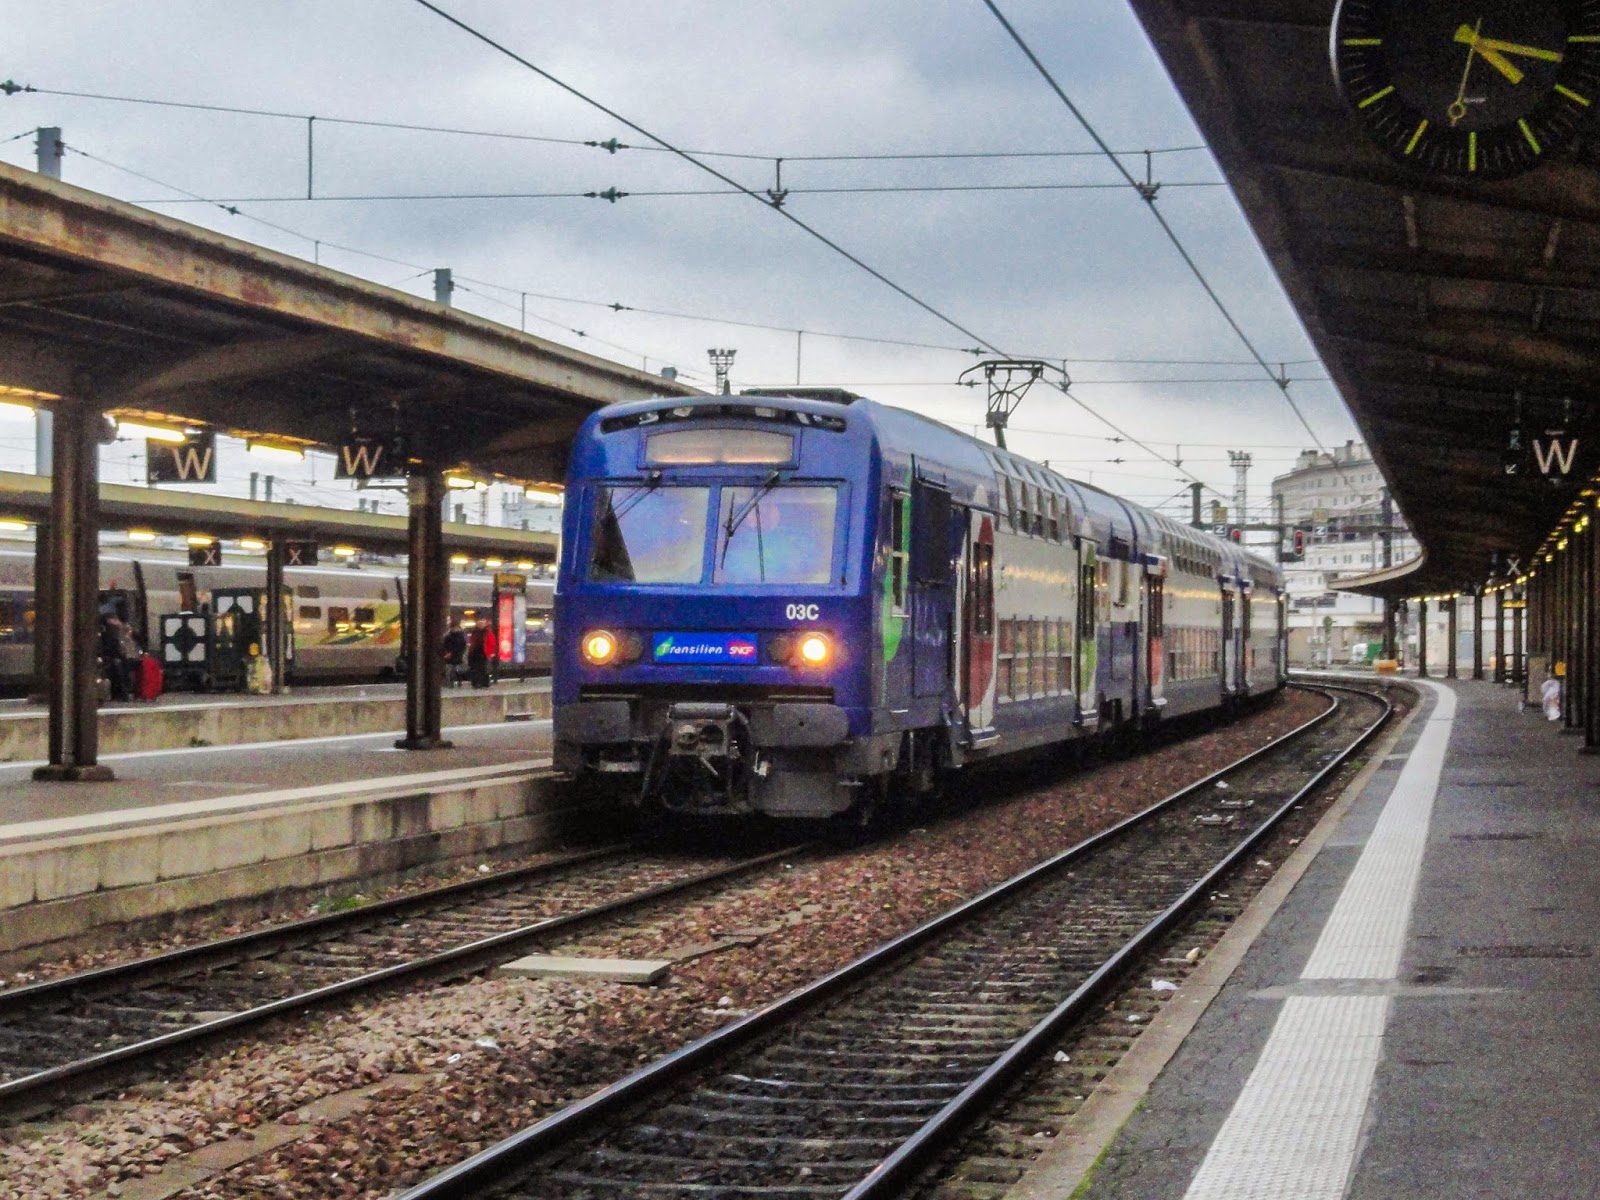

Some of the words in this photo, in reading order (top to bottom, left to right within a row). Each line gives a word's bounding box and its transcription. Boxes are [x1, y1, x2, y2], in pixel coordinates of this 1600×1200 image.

[172, 447, 212, 480] W
[342, 445, 383, 476] W
[1532, 439, 1578, 474] W
[204, 549, 216, 566] X
[288, 548, 302, 566] X
[1506, 558, 1521, 576] X
[786, 604, 819, 620] 03C
[660, 643, 722, 654] Transilien
[729, 646, 754, 655] SNCF
